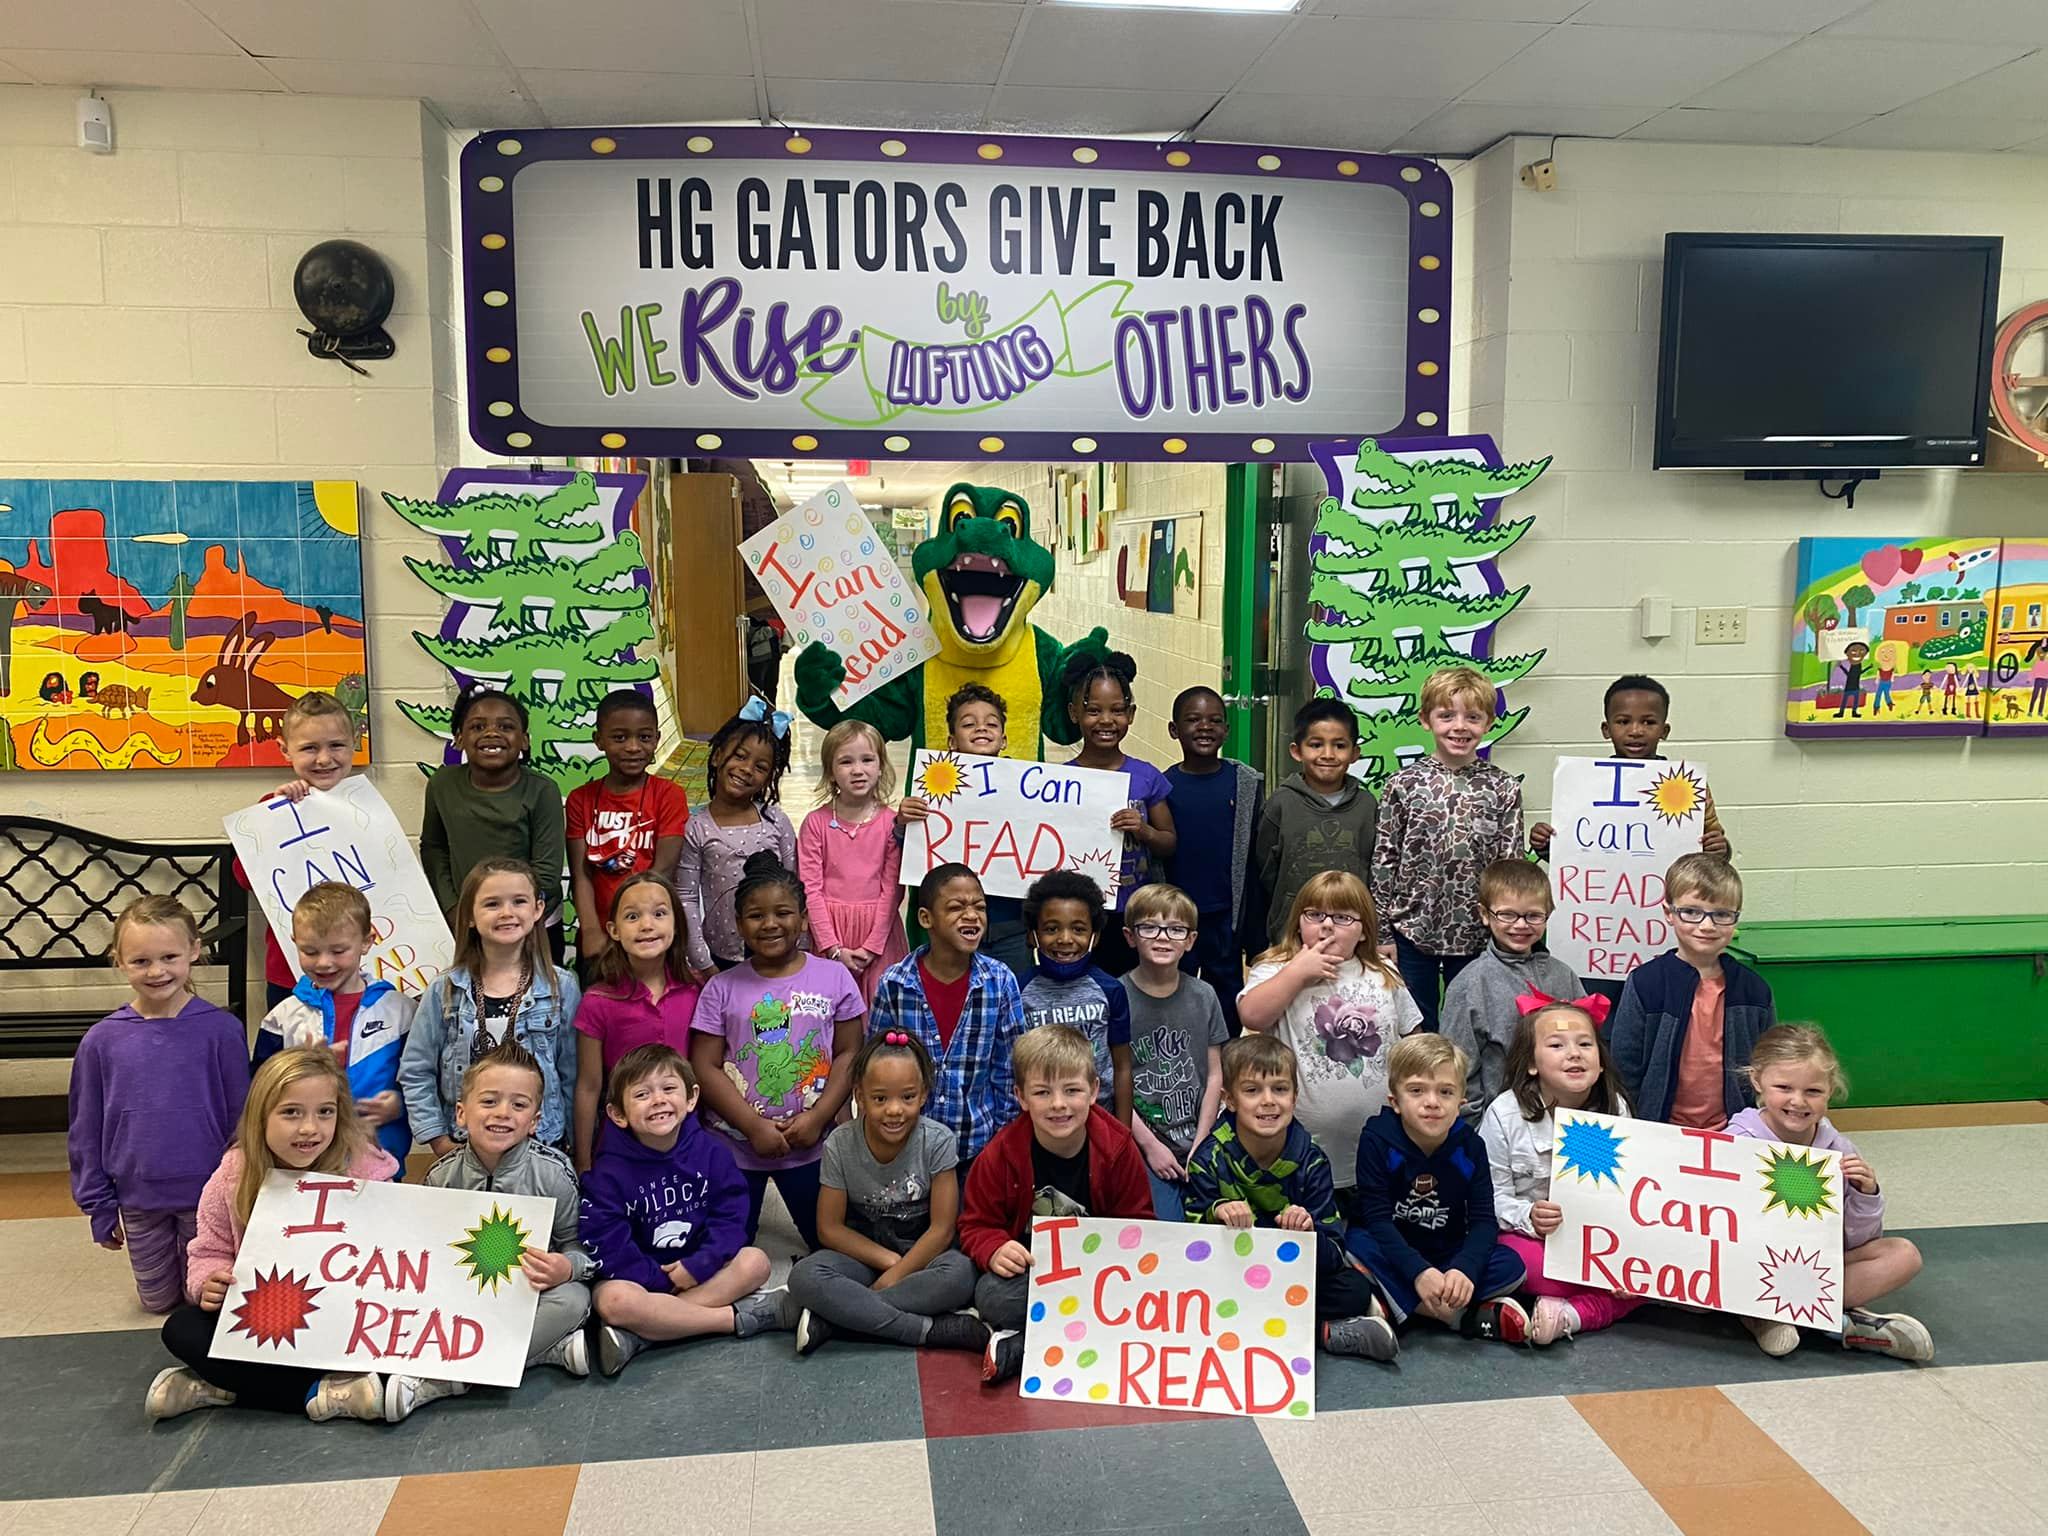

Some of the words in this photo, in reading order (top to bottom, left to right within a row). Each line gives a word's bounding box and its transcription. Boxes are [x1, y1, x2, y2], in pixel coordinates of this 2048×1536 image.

[637, 177, 714, 269] HG
[737, 177, 968, 274] GATORS
[988, 184, 1116, 277] GIVE
[1137, 190, 1284, 282] BACK
[936, 281, 991, 338] by
[580, 302, 677, 397] WE
[678, 277, 862, 400] Rise
[886, 323, 1054, 406] LIFTING
[1114, 295, 1313, 419] OTHERS
[757, 542, 815, 610] I
[814, 565, 885, 609] can
[972, 761, 997, 797] I
[1020, 766, 1082, 805] Can
[1593, 761, 1645, 807] I
[268, 799, 330, 849] I
[923, 809, 1065, 880] READ
[1559, 865, 1666, 909] READ
[1571, 912, 1667, 946] READ
[1588, 948, 1645, 975] REA
[1027, 1009, 1047, 1027] ET
[1052, 1004, 1105, 1024] READY
[1130, 1036, 1156, 1064] WE
[1679, 1128, 1741, 1182] I
[282, 1179, 358, 1238] I
[625, 1179, 708, 1216] WILDCA
[639, 1174, 679, 1194] ONCE
[1629, 1176, 1738, 1243] Can
[319, 1242, 431, 1294] CAN
[1032, 1217, 1082, 1286] I
[1581, 1225, 1722, 1309] Read
[1093, 1265, 1211, 1336] Can
[345, 1298, 484, 1362] READ
[1118, 1342, 1295, 1414] READ
